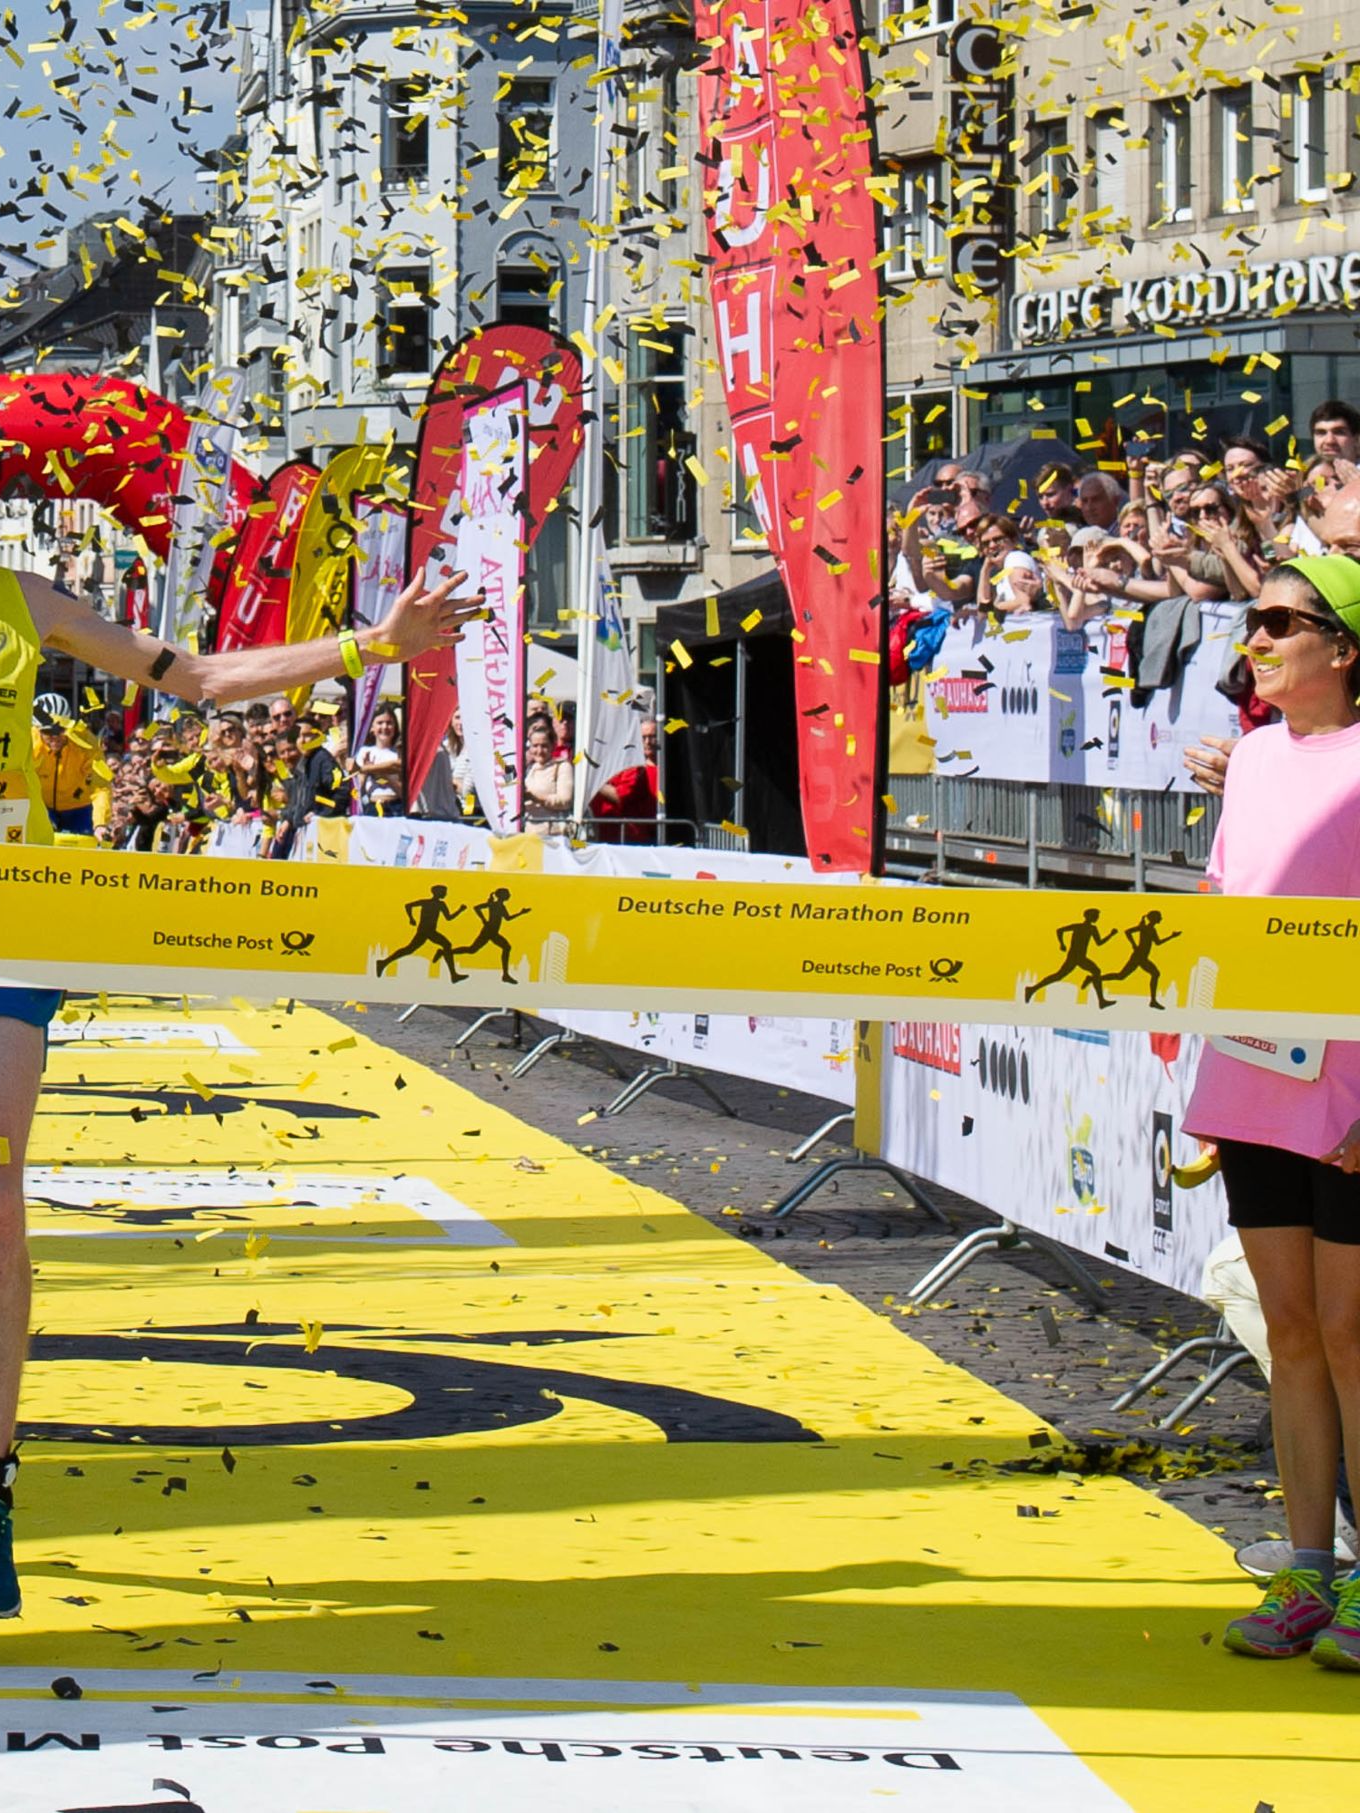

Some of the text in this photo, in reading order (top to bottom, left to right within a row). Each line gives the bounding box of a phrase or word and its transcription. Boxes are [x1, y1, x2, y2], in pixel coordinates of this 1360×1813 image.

[81, 869, 129, 888] Post
[139, 873, 251, 894] Marathon
[261, 880, 318, 898] Bonn
[618, 896, 970, 924] Deutsche Post Marathon Bonn
[1266, 918, 1358, 937] Deutsch
[153, 931, 273, 950] Deutsche Post
[802, 960, 921, 977] Deutsche Post
[1228, 1034, 1277, 1053] AUHAUS
[146, 1733, 386, 1755] Post
[433, 1739, 962, 1771] Deutsche
